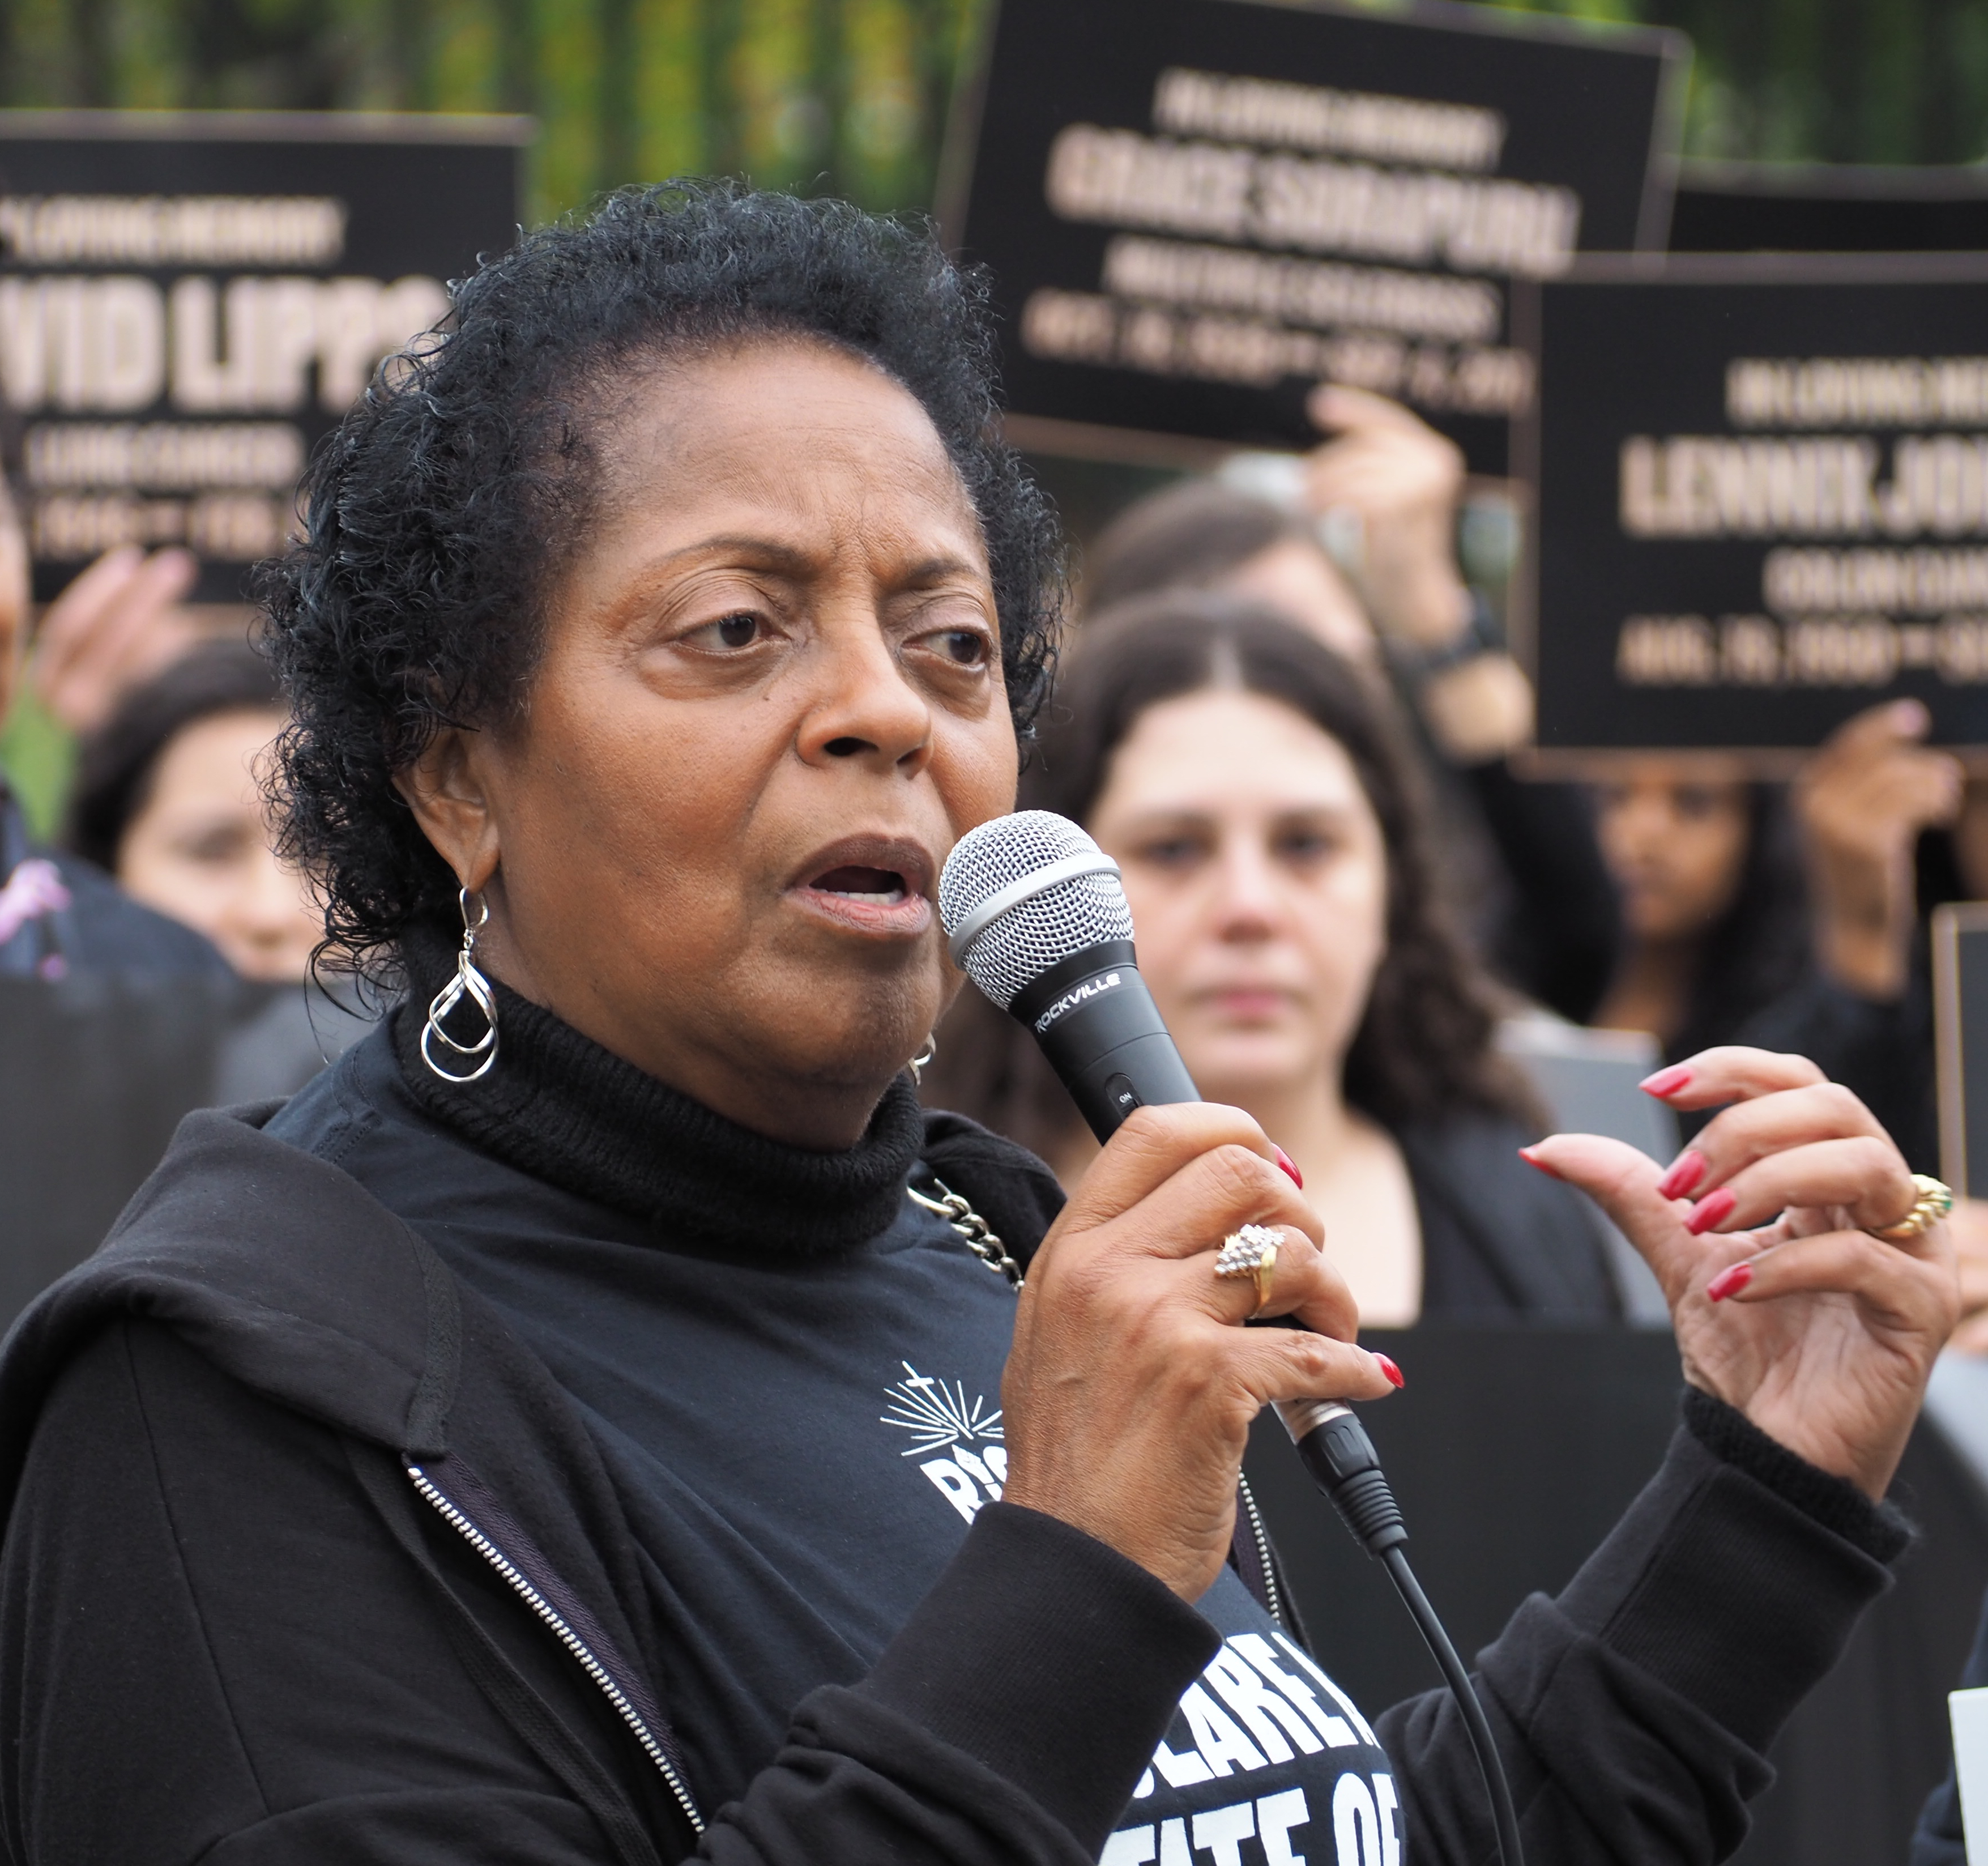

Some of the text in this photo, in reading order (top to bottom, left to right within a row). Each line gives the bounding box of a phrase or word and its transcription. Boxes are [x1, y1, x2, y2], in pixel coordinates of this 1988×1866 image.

[1034, 973, 1121, 1034] ROCKVILLE
[1119, 1092, 1133, 1104] ON
[1133, 1633, 1359, 1799] LARE
